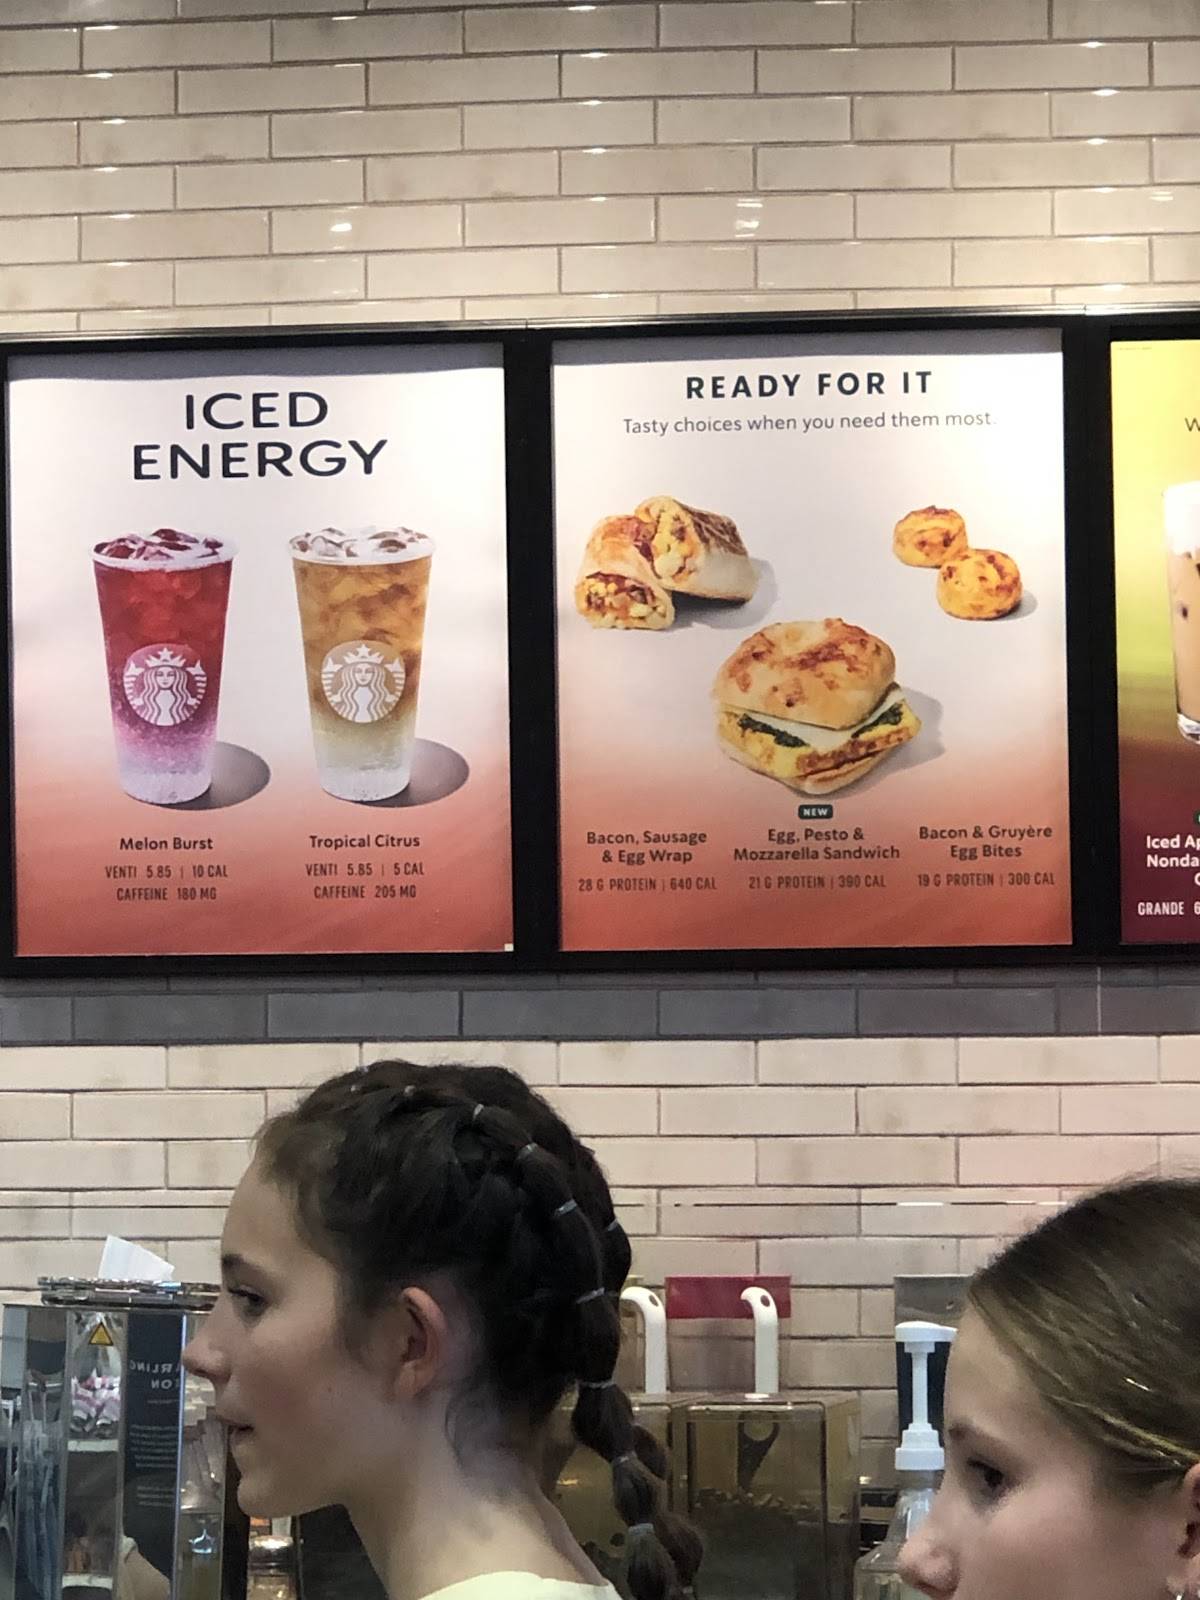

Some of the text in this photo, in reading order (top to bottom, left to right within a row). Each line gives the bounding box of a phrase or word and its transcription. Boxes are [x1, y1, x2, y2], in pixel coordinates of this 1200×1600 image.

[686, 371, 932, 399] READY FOR IT
[186, 391, 329, 430] ICED
[624, 417, 669, 437] Tasty
[674, 415, 742, 433] choices
[747, 414, 797, 431] when
[802, 416, 834, 434] you
[840, 412, 886, 429] need
[892, 412, 940, 428] them
[134, 439, 388, 480] ENERGY
[803, 808, 829, 816] NEW
[586, 830, 707, 846] Bacon, Sausage
[768, 827, 864, 844] Egg, Pesto &
[919, 824, 1053, 841] Bacon & Gruyère
[119, 837, 214, 850] Melon Burst
[309, 834, 420, 850] Tropical Citrus
[1146, 834, 1181, 849] Iced
[601, 849, 693, 865] & Egg Wrap
[733, 845, 900, 861] Mozzarella Sandwich
[950, 844, 1022, 861] Egg Bites
[105, 865, 137, 879] VENTI
[146, 864, 172, 878] 5.85
[192, 865, 204, 878] 10
[207, 864, 229, 878] CAL
[305, 863, 338, 876] VENTI
[347, 863, 373, 876] 5.85
[393, 862, 401, 875] 5
[403, 862, 425, 876] CAL
[578, 878, 593, 892] 28
[596, 878, 604, 891] G
[609, 877, 657, 891] PROTEIN
[670, 877, 692, 891] 640
[695, 876, 717, 891] CAL
[749, 876, 761, 889] 21
[764, 876, 772, 889] G
[777, 875, 825, 889] PROTEIN
[864, 874, 887, 888] CAL
[918, 874, 930, 887] 19
[933, 874, 941, 887] G
[946, 873, 994, 886] PROTEIN
[1008, 872, 1030, 885] 300
[1034, 872, 1055, 885] CAL
[116, 887, 217, 901] CAFFEINE 180 MG
[313, 885, 417, 899] CAFFEINE 205 MG
[1137, 901, 1185, 916] GRANDE
